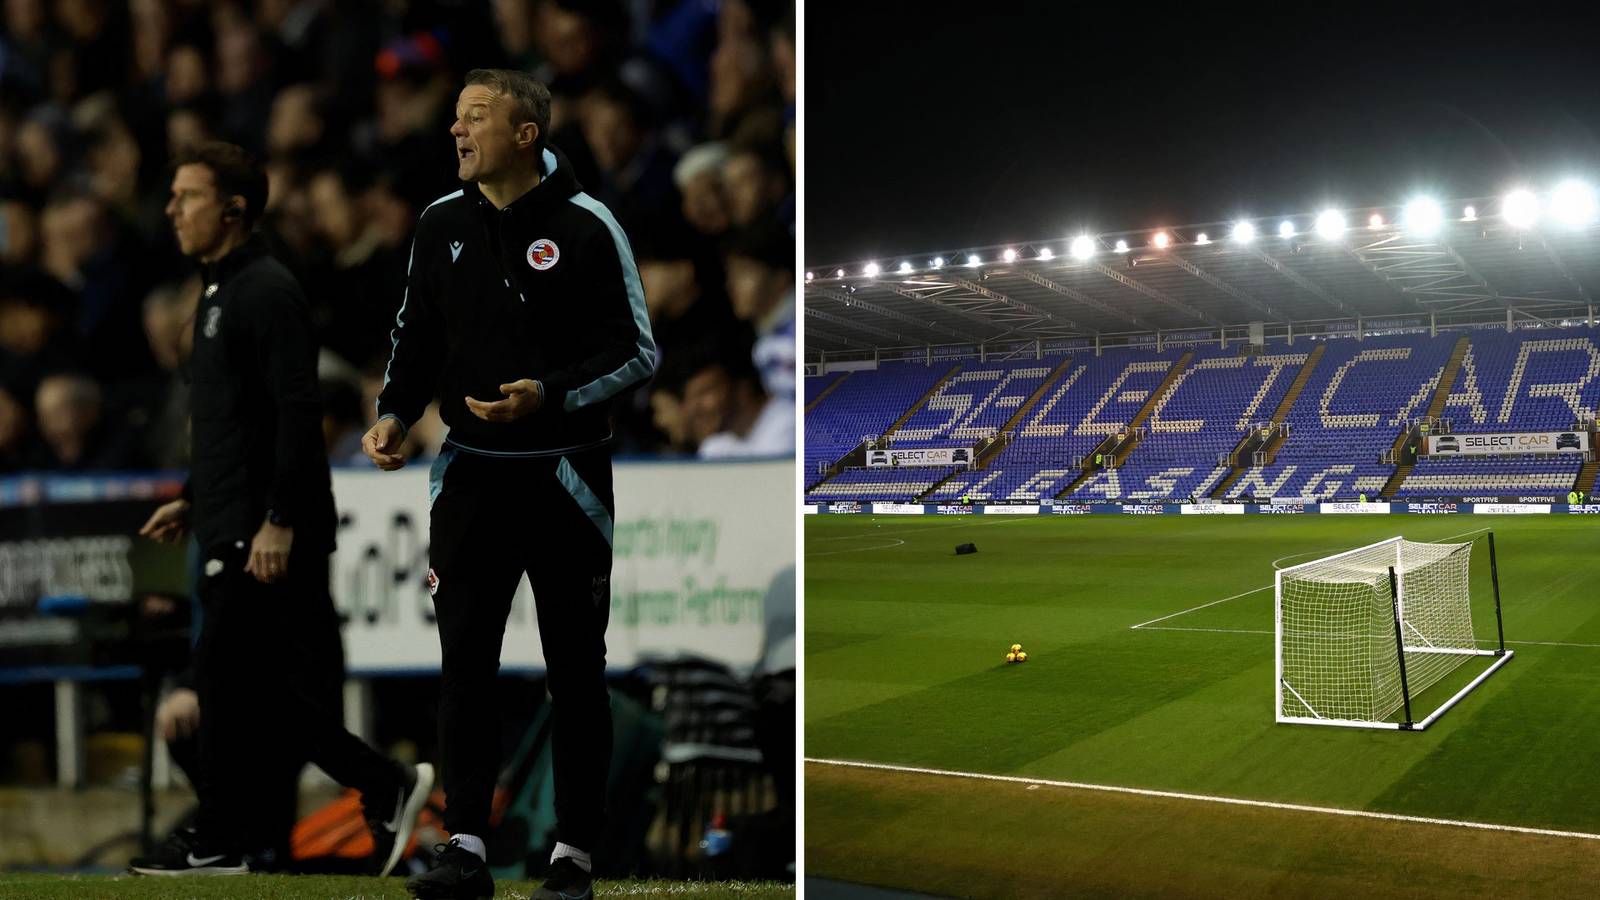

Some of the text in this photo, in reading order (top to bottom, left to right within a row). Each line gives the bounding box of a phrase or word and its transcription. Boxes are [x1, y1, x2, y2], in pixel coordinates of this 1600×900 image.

[892, 338, 1600, 440] SELECT CAR
[1465, 435, 1549, 447] SELECT CAR
[891, 450, 948, 460] SELECT CAR
